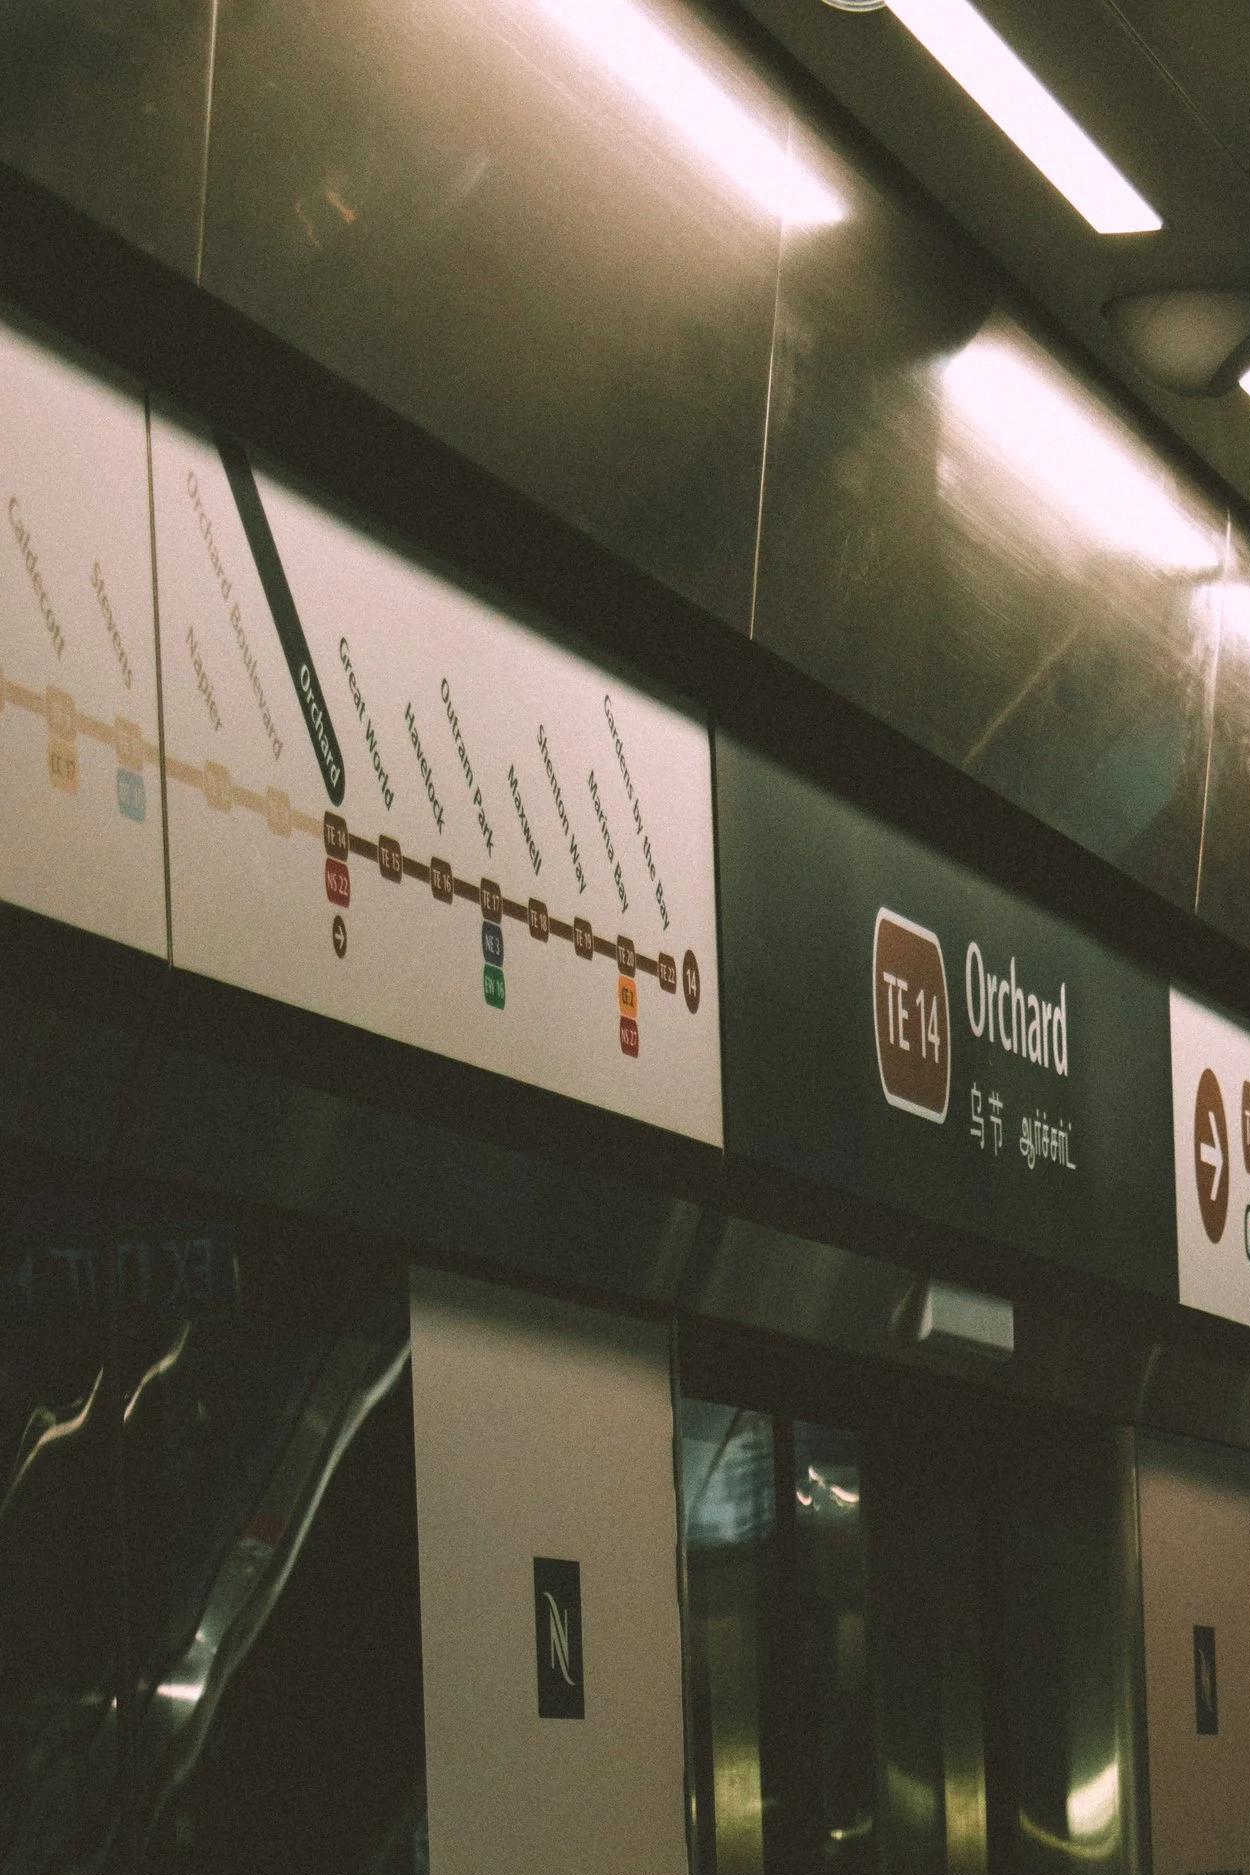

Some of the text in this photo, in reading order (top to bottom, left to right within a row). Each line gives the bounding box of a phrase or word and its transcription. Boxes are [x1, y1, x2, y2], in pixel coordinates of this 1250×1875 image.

[90, 558, 134, 691] Stevens
[187, 469, 232, 601] Orchard
[230, 602, 284, 761] Boulevard
[185, 623, 224, 733] Napier
[300, 663, 341, 788] Orchard
[339, 636, 395, 812] Great World
[404, 701, 446, 836] Havelock
[440, 677, 495, 859] Outram Park
[537, 723, 588, 896] Shenton Way
[325, 824, 347, 851] TE 14
[507, 763, 543, 877] Maxwell
[587, 768, 630, 915] Marina Bay
[603, 694, 671, 932] Gardens by the Bay
[326, 870, 349, 897] NS 22
[380, 846, 401, 873] TE 15
[432, 868, 442, 889] TE
[481, 889, 492, 910] TE
[484, 933, 495, 954] NE
[529, 909, 539, 929] TE
[574, 928, 584, 948] TE
[617, 945, 627, 965] TE
[659, 963, 676, 985] TE 22
[685, 968, 698, 998] 14
[964, 940, 1069, 1078] Orchard
[620, 1026, 630, 1045] NS
[882, 970, 941, 1065] TE 14
[969, 1081, 1005, 1157] 乌节
